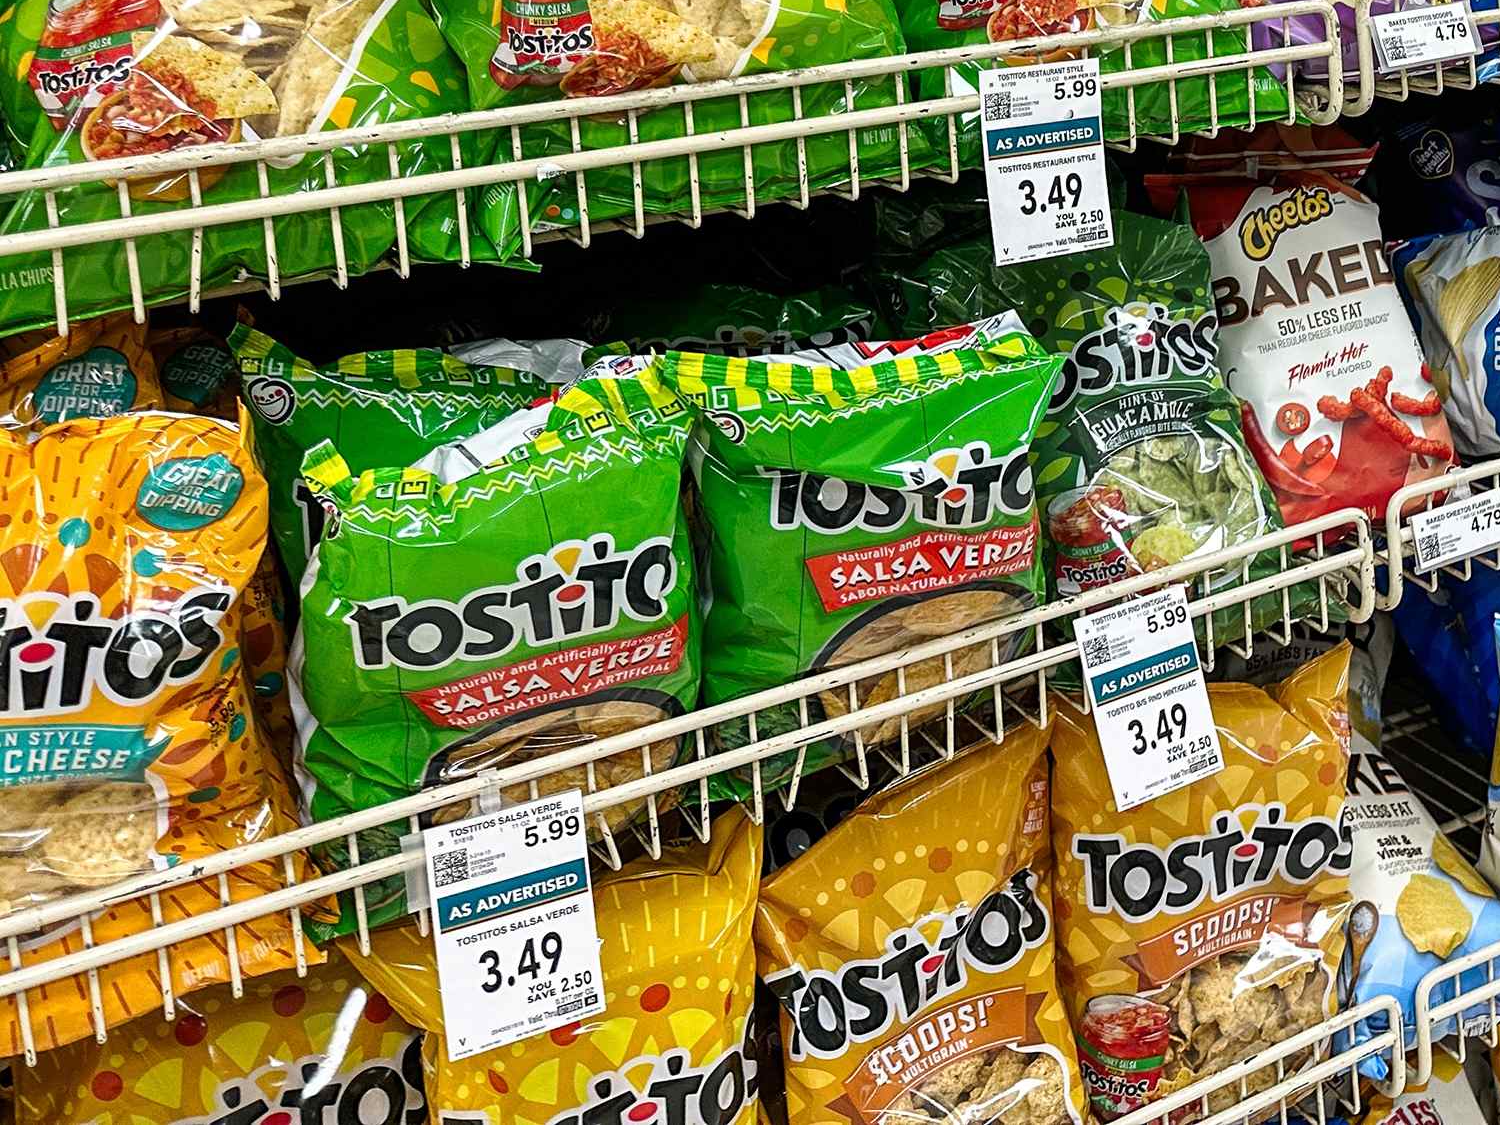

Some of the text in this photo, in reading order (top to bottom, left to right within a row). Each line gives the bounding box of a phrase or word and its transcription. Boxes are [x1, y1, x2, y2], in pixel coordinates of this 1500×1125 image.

[546, 3, 571, 15] SALSA
[1388, 17, 1406, 27] BAKED
[1407, 13, 1432, 24] TOSTITOS
[508, 25, 593, 55] TOSTITOS
[1435, 23, 1468, 42] 4.79
[38, 56, 133, 93] TOSTITOS
[1054, 79, 1097, 100] 5.99
[996, 127, 1094, 151] AS ADVERTISED
[1018, 172, 1083, 216] 3.49
[1278, 302, 1362, 336] 50% LESS FAT
[51, 360, 126, 384] GREAT
[1326, 361, 1372, 377] FLAVORED
[162, 461, 240, 490] GREAT
[142, 493, 223, 517] DIPPING
[179, 486, 203, 498] FOR
[837, 530, 990, 563] Naturally and Artificially
[831, 537, 1033, 589] SALSA VERDE
[839, 557, 1032, 603] SABOR NATURAL Y ARTIFICIAL
[1148, 606, 1187, 633] 5.99
[434, 637, 675, 715] SALSA VERDE
[438, 627, 675, 697] Naturally and Artificially Flavored
[1101, 654, 1191, 697] AS ADVERTISED
[30, 732, 96, 747] STYLE
[1127, 703, 1188, 756] 3.49
[4, 748, 132, 772] CHEESE
[1167, 744, 1183, 754] YOU
[1167, 735, 1212, 764] SAVE 2.50
[524, 815, 579, 848] 5.99
[1375, 845, 1422, 863] vinegar
[449, 872, 578, 920] AS ADVERTISED
[457, 904, 579, 947] TOSTITOS SALSA VERDE
[1174, 905, 1271, 958] SCOOPS!
[1196, 928, 1256, 958] MULTIGRAIN
[479, 932, 562, 993] 3.49
[900, 1038, 970, 1084] MULTIGRAIN
